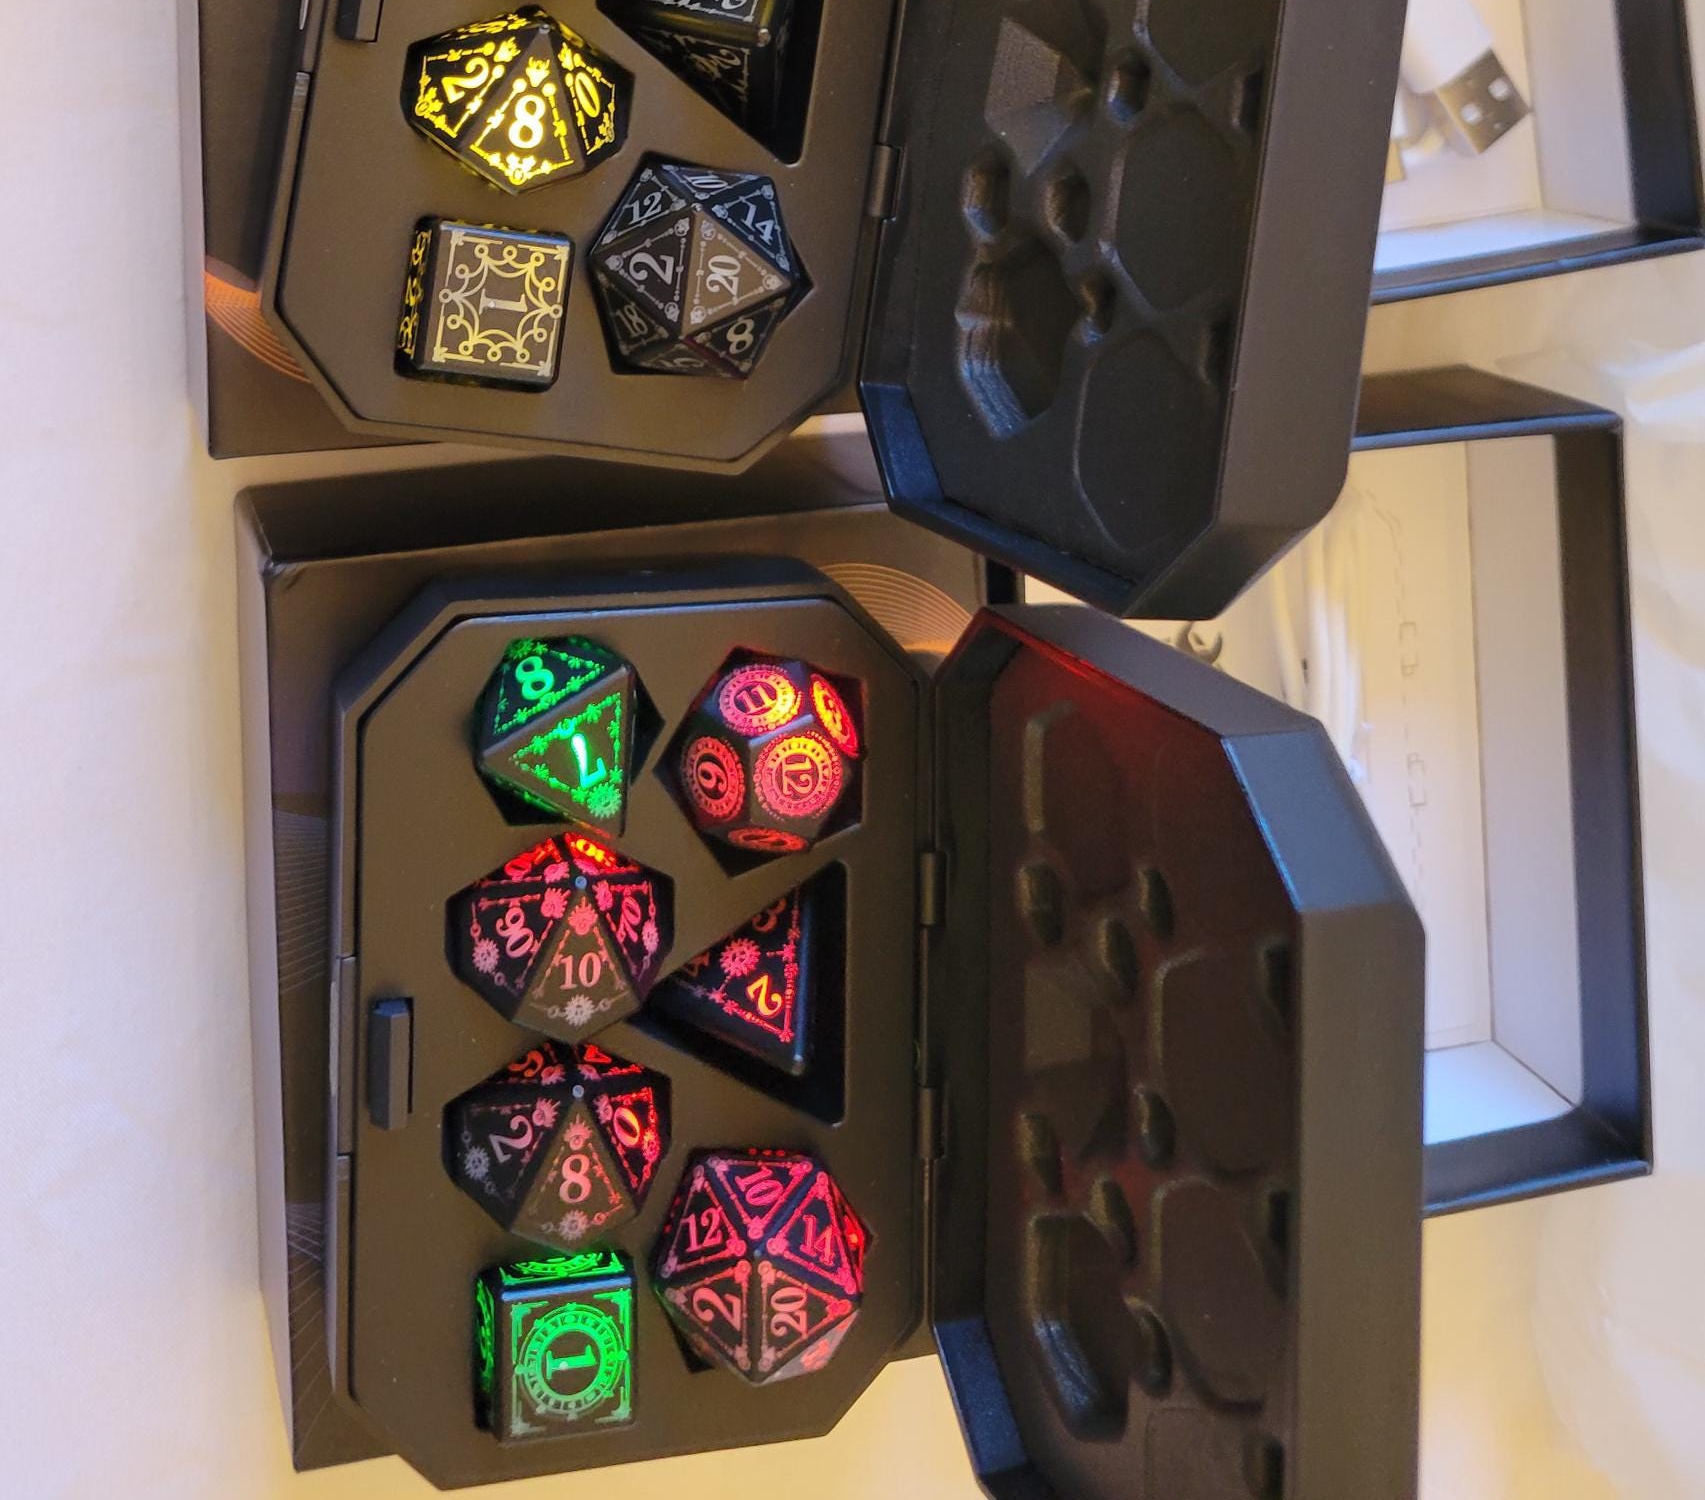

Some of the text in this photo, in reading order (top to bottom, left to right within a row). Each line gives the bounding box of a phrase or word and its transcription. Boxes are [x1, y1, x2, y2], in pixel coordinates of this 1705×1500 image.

[441, 57, 489, 104] 2
[574, 71, 601, 118] 0
[508, 94, 547, 149] 8
[626, 191, 663, 226] 12
[741, 201, 776, 245] 14
[629, 251, 674, 285] 2
[706, 255, 741, 296] 20
[479, 288, 528, 315] 1
[615, 304, 648, 338] 18
[726, 318, 755, 354] 8
[515, 655, 555, 701] 8
[736, 684, 775, 714] 11
[570, 732, 608, 788] 7
[782, 756, 814, 796] 12
[560, 952, 602, 990] 10
[746, 974, 783, 1017] 2
[489, 1115, 533, 1164] 2
[613, 1106, 641, 1148] 0
[559, 1154, 592, 1204] 8
[734, 1165, 784, 1207] 10
[681, 1208, 723, 1253] 12
[800, 1215, 836, 1267] 14
[692, 1287, 741, 1331] 2
[770, 1286, 808, 1339] 20
[546, 1344, 598, 1380] 1
